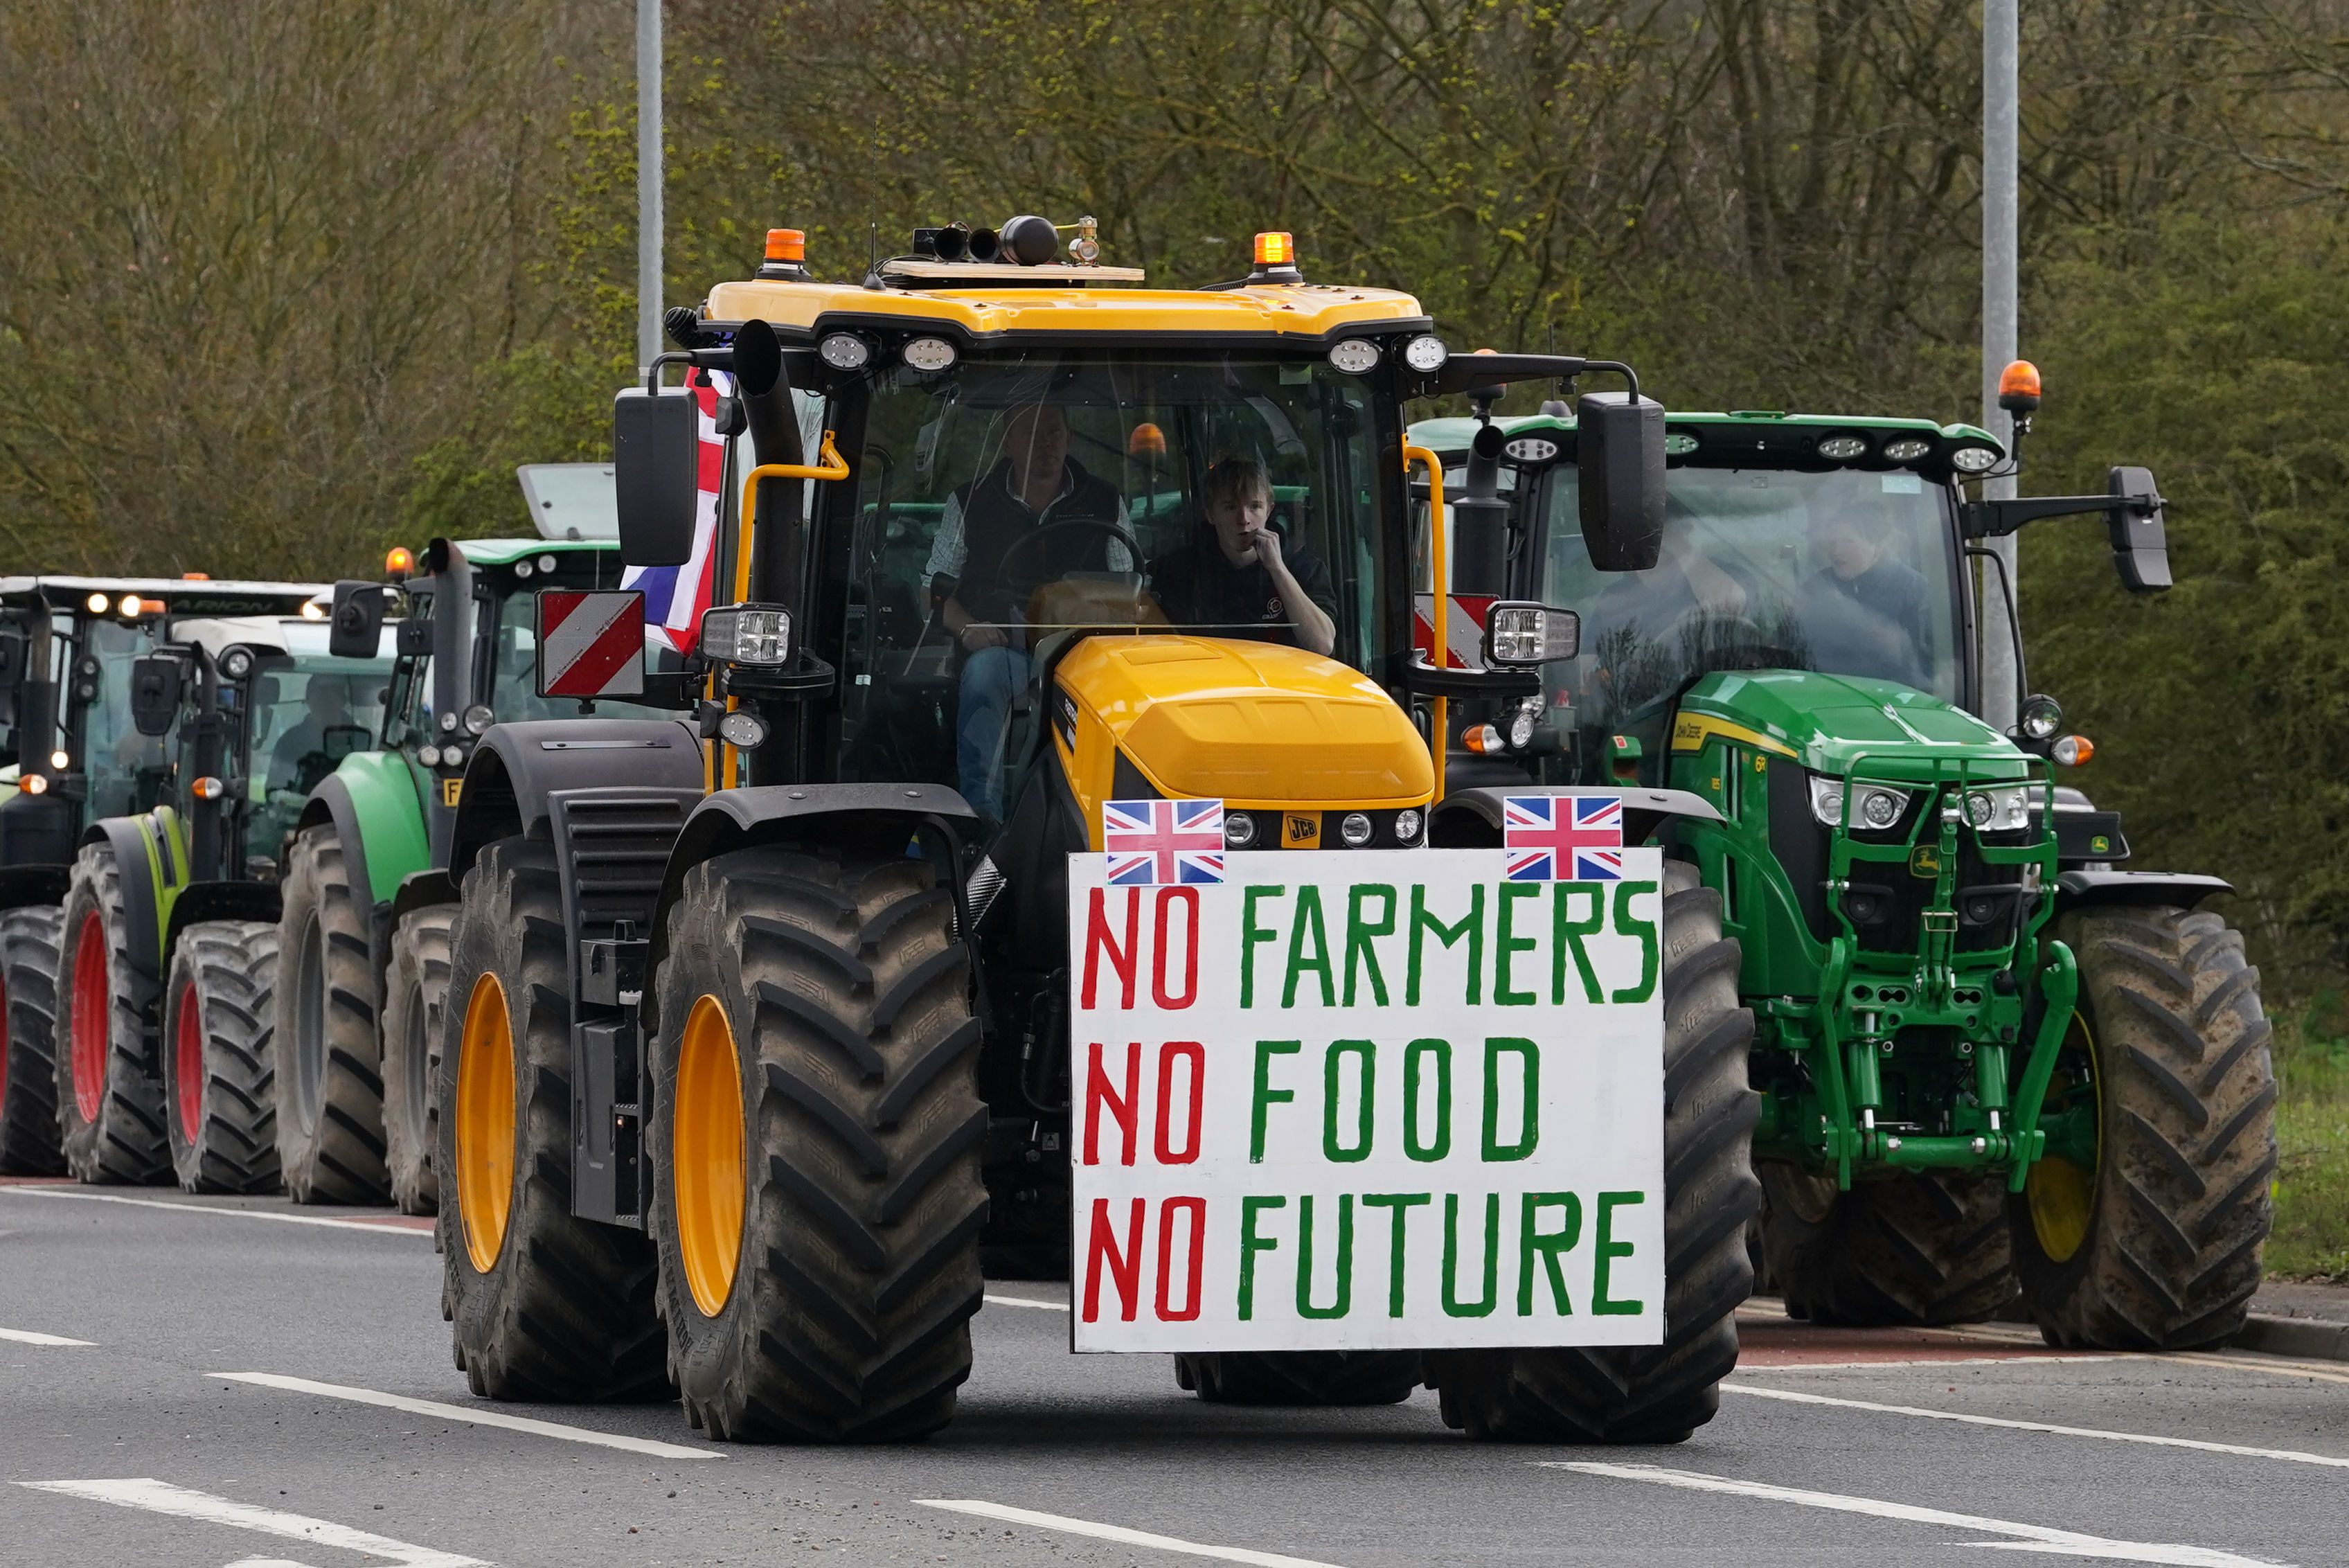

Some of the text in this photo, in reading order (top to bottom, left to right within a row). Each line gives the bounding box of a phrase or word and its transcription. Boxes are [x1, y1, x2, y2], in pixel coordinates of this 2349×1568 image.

[1292, 819, 1315, 839] JCB
[1081, 882, 1659, 1010] NO FARMERS
[1084, 1038, 1539, 1166] NO FOOD
[1082, 1192, 1644, 1322] NO FUTURE
